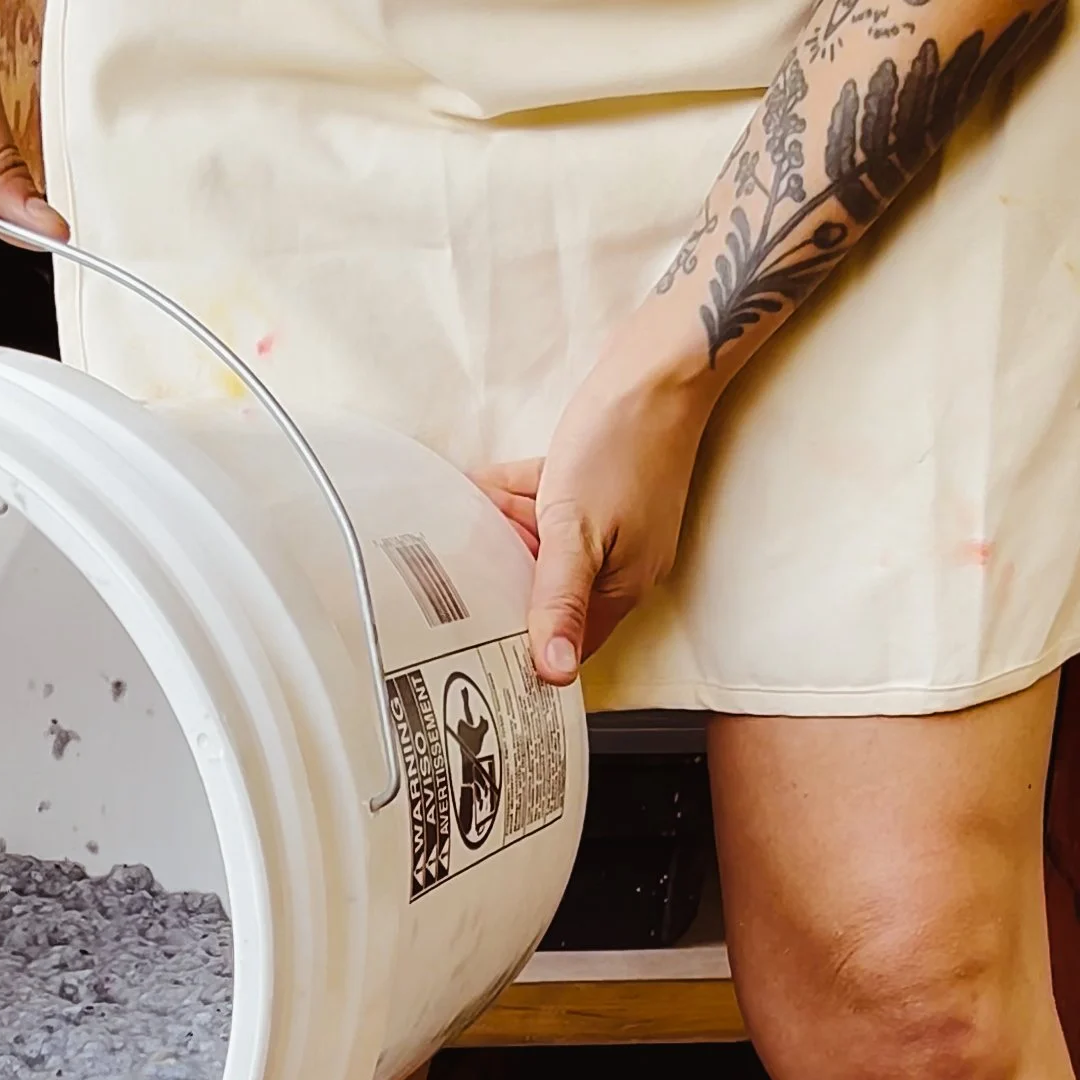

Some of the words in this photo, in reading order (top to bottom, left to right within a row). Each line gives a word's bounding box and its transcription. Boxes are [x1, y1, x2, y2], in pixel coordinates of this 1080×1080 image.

[390, 696, 424, 853] WARNING
[411, 675, 450, 835] AVERTISSEMENT
[414, 730, 437, 825] AVISO
